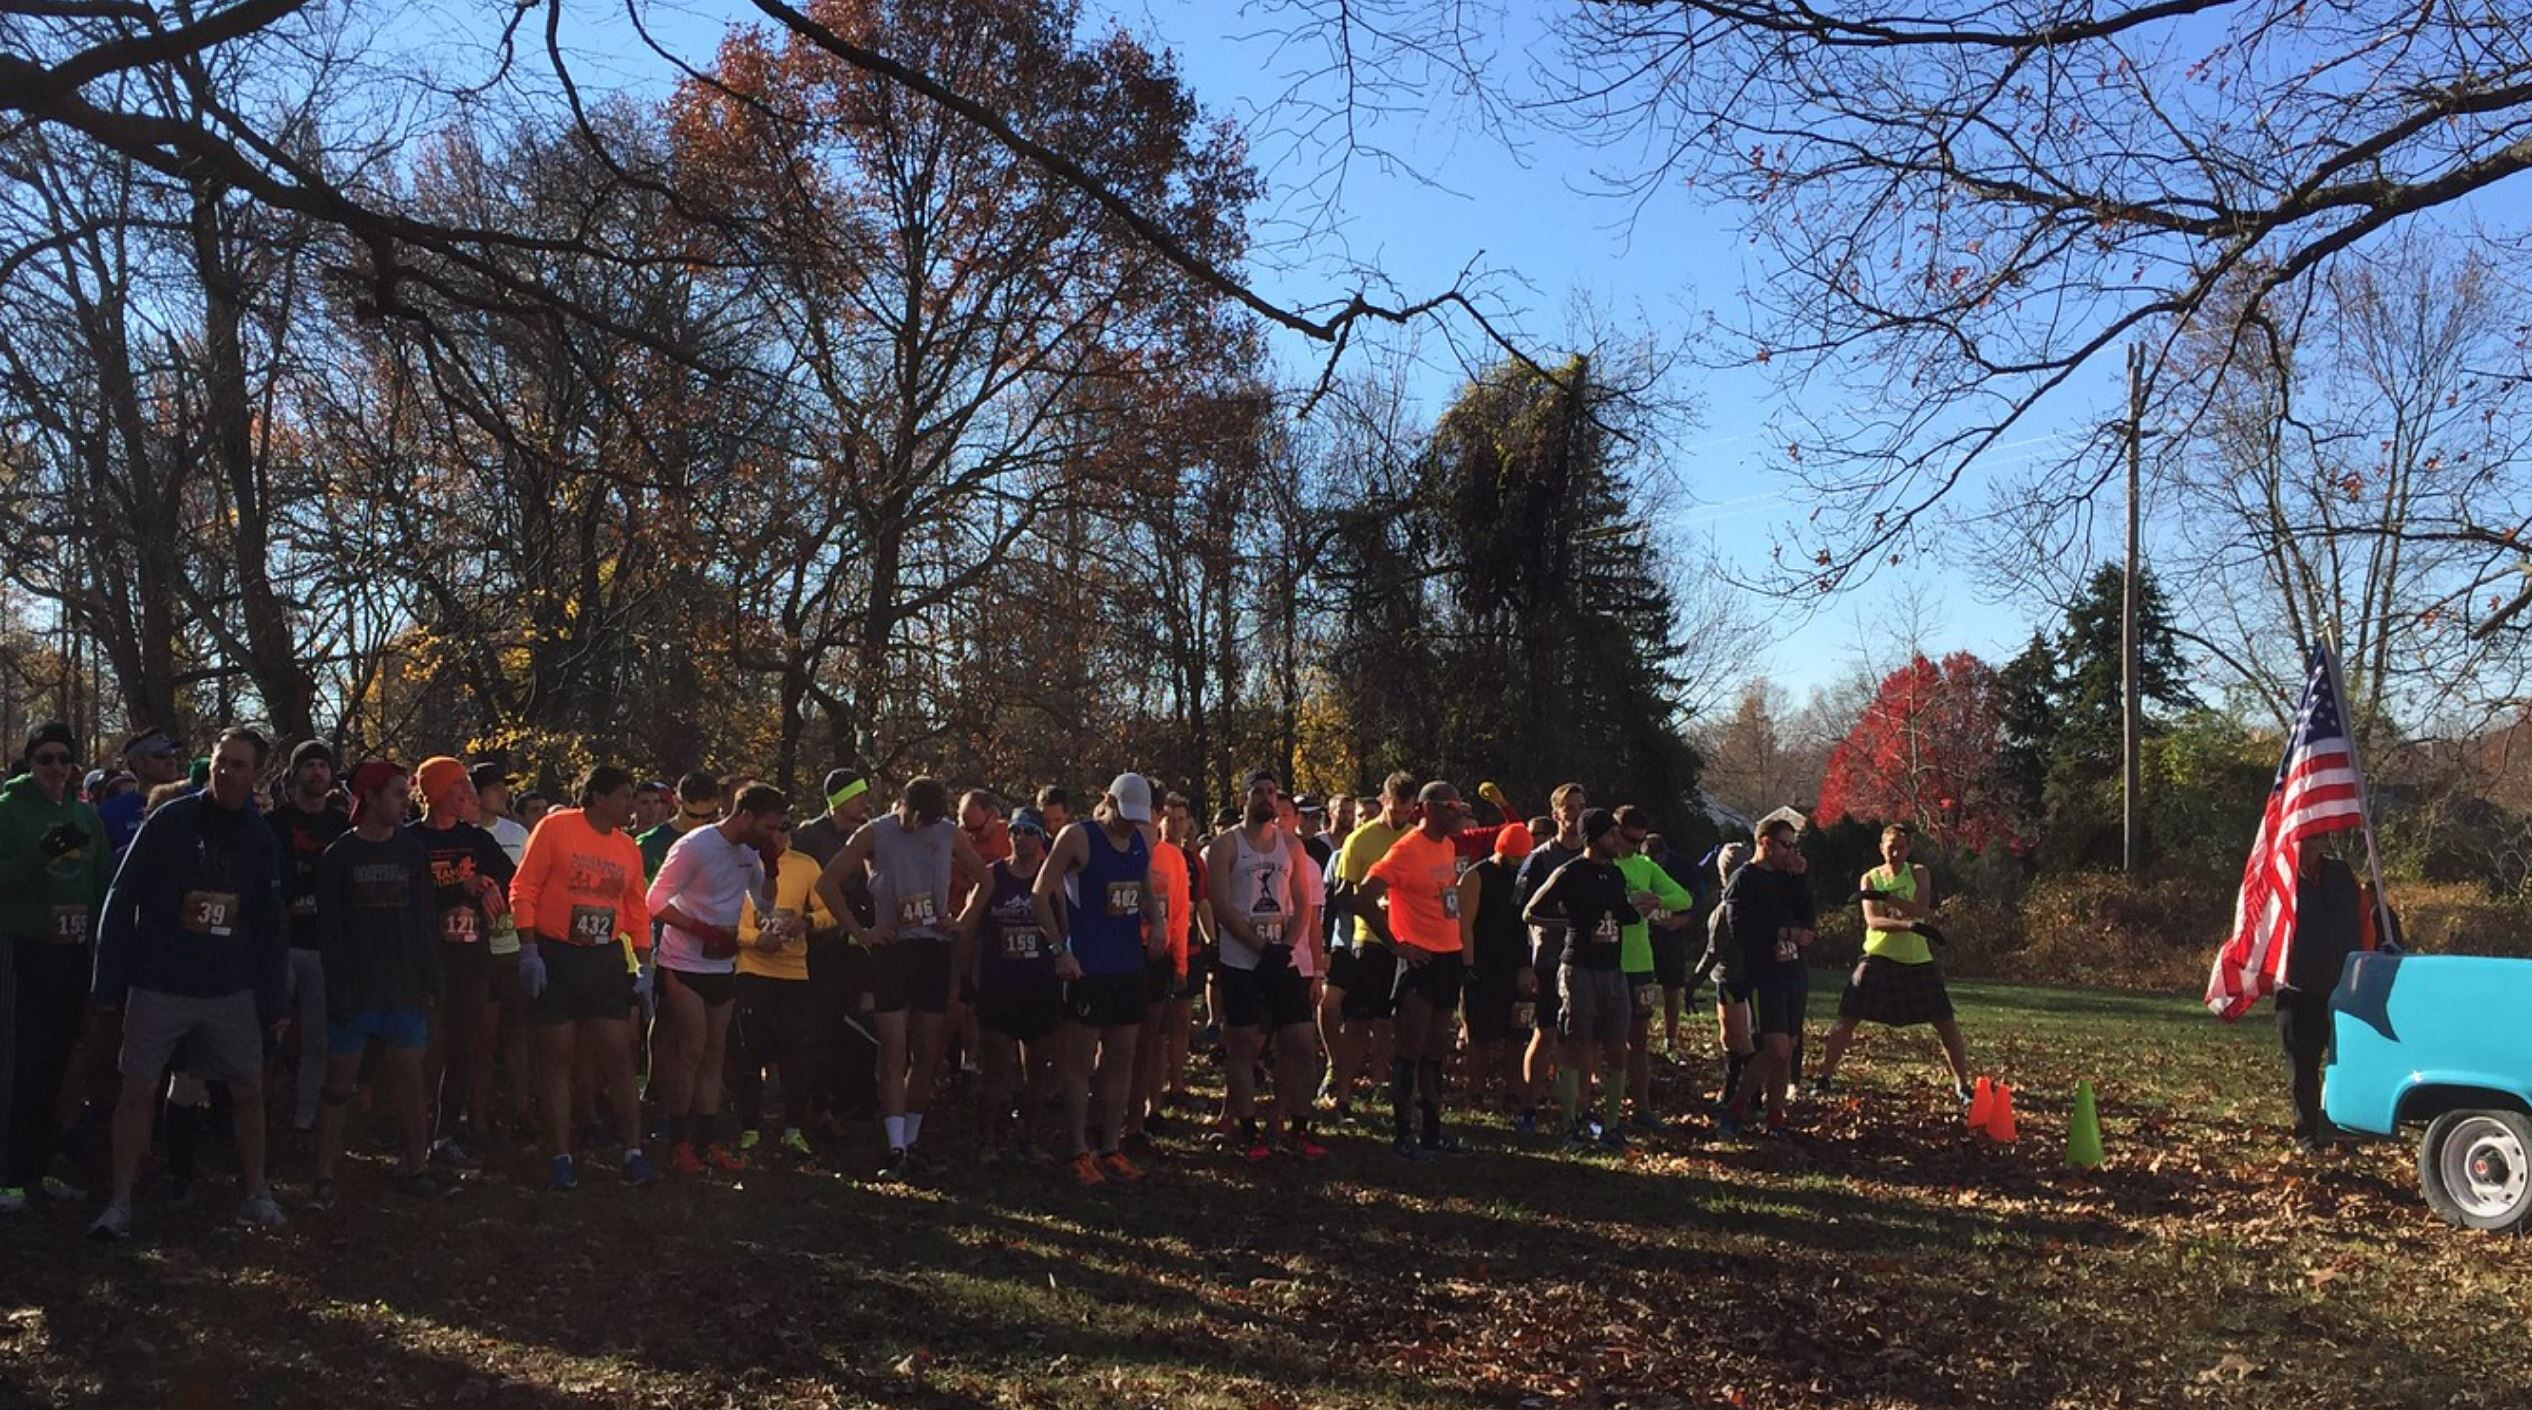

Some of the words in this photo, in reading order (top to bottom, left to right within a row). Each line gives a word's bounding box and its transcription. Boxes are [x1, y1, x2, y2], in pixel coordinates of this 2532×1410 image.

[197, 901, 226, 925] 39
[447, 915, 475, 934] 121
[577, 914, 611, 936] 432
[1008, 934, 1036, 952] 159
